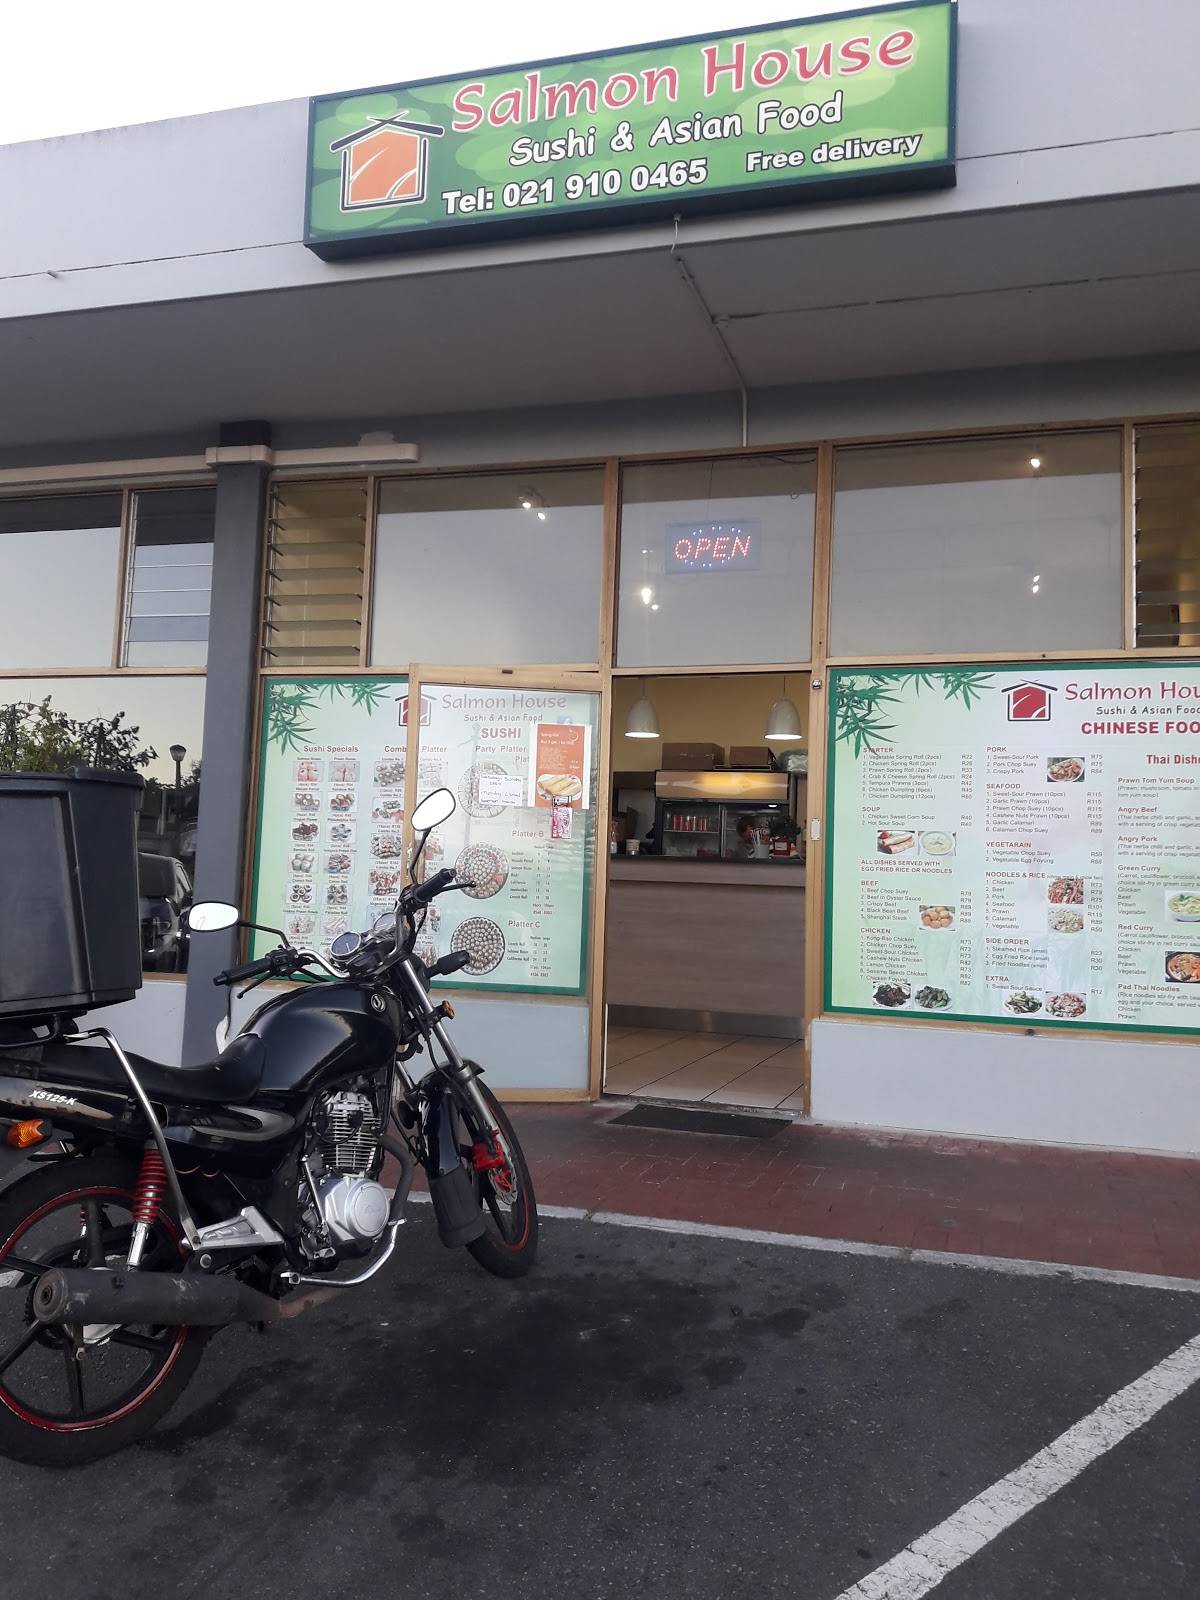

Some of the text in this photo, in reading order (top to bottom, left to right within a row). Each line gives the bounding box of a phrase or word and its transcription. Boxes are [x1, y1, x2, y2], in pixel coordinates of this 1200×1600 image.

[451, 30, 915, 132] Salmon House
[508, 89, 844, 166] Sushi & Asian Food
[746, 133, 923, 173] Free delivery
[442, 157, 708, 215] Tel: 021 910 0465
[675, 536, 751, 559] OPEN
[1065, 682, 1151, 701] Salmon
[442, 694, 567, 709] Salmon House
[1096, 706, 1125, 715] Sushi
[1130, 706, 1137, 715] &
[1142, 706, 1172, 715] Asian
[464, 714, 486, 722] Sushi
[523, 714, 543, 722] Food
[481, 728, 521, 739] SUSHI
[1081, 722, 1159, 734] CHINESE
[327, 746, 358, 754] Specials
[475, 745, 526, 753] Party Platter
[1146, 755, 1170, 764] Thai
[508, 920, 534, 928] Platter
[29, 1090, 78, 1106] XS125-K
